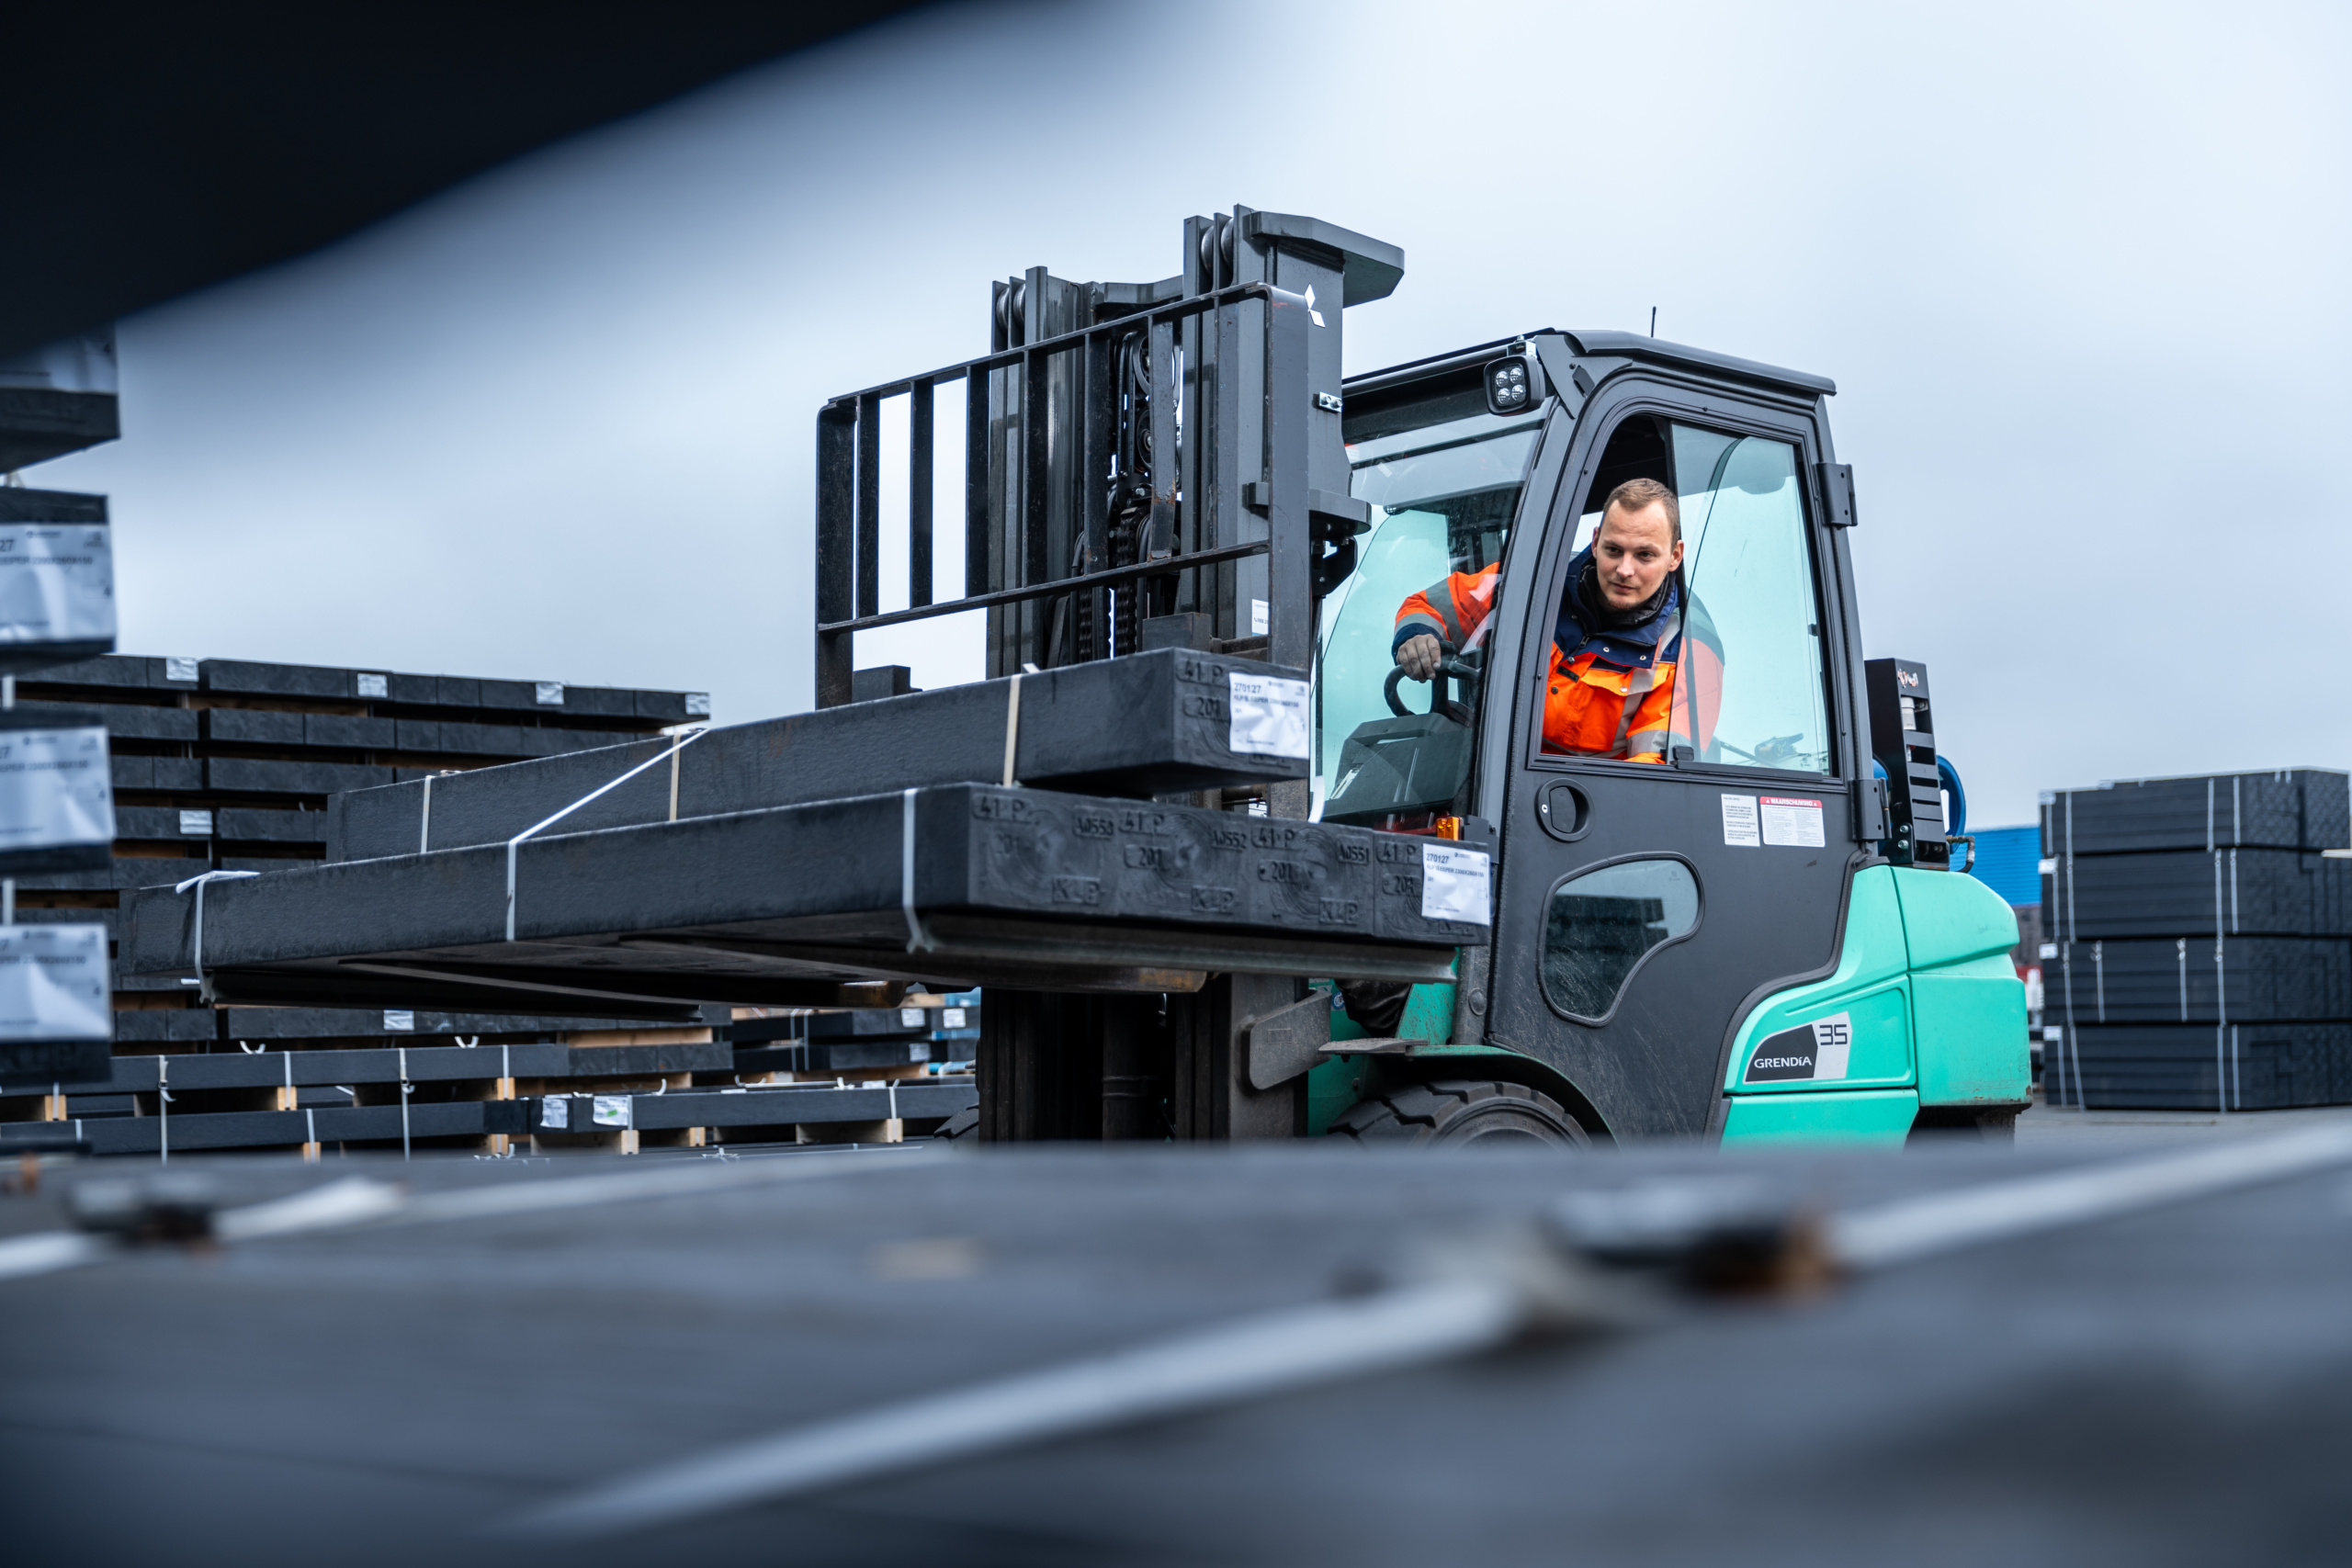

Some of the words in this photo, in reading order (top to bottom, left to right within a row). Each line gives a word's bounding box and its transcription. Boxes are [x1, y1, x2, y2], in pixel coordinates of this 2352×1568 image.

[1234, 682, 1261, 694] 270127
[1426, 852, 1450, 864] 270127
[1819, 1023, 1848, 1045] 35
